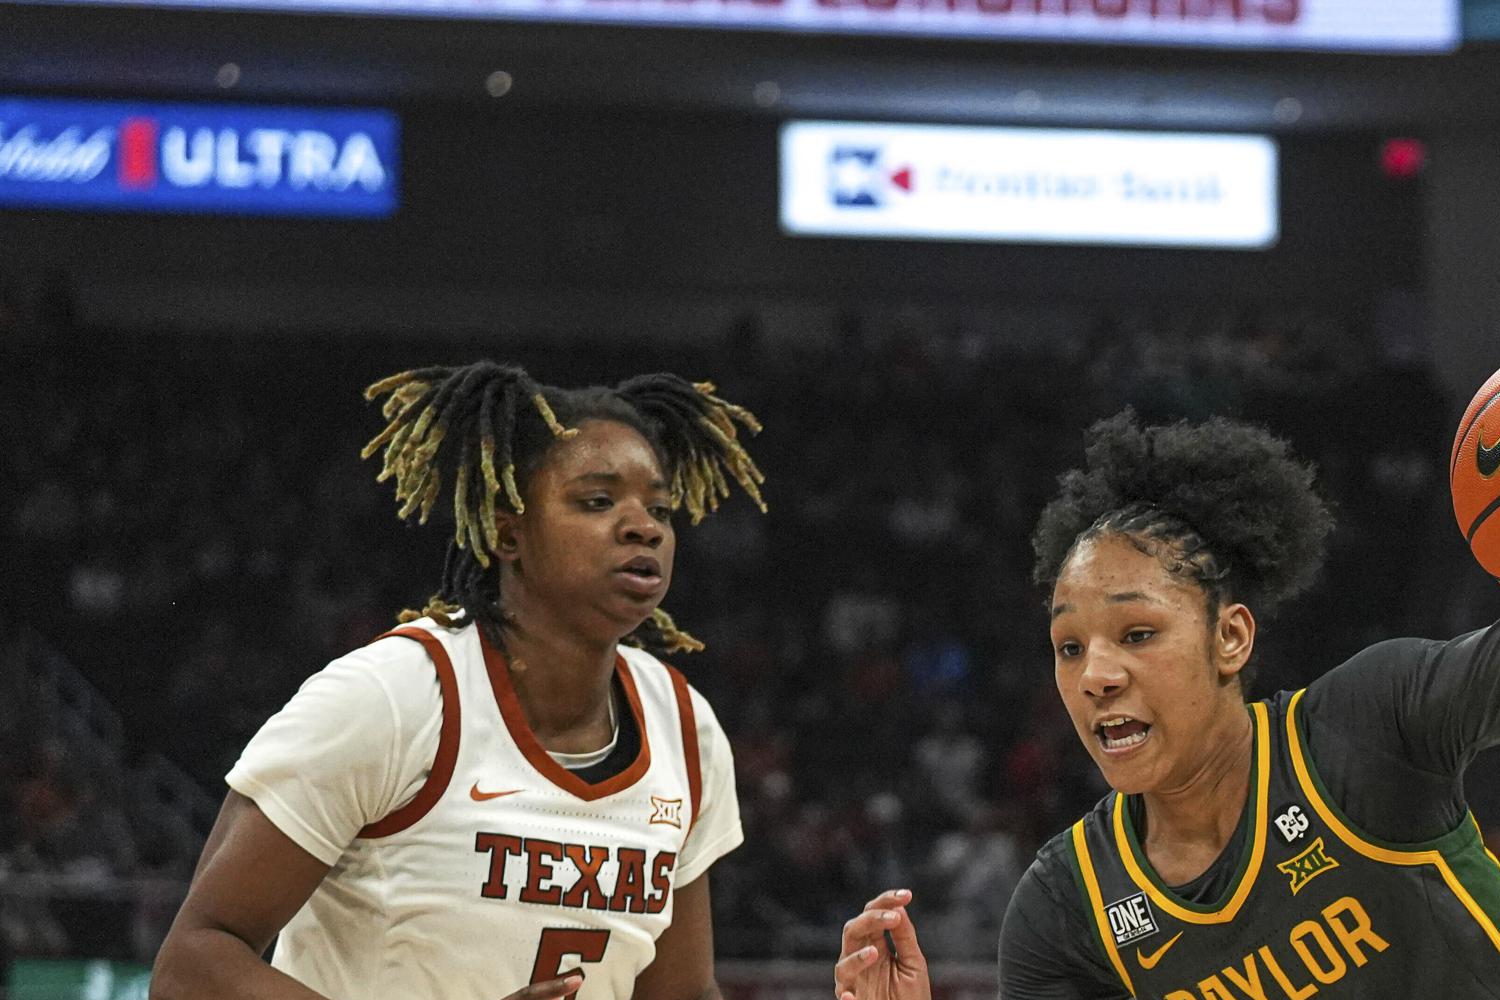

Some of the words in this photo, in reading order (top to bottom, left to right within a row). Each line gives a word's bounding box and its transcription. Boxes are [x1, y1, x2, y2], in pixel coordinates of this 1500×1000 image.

[162, 125, 387, 191] ULTRA
[475, 832, 676, 914] TEXAS
[1108, 896, 1150, 935] ONE
